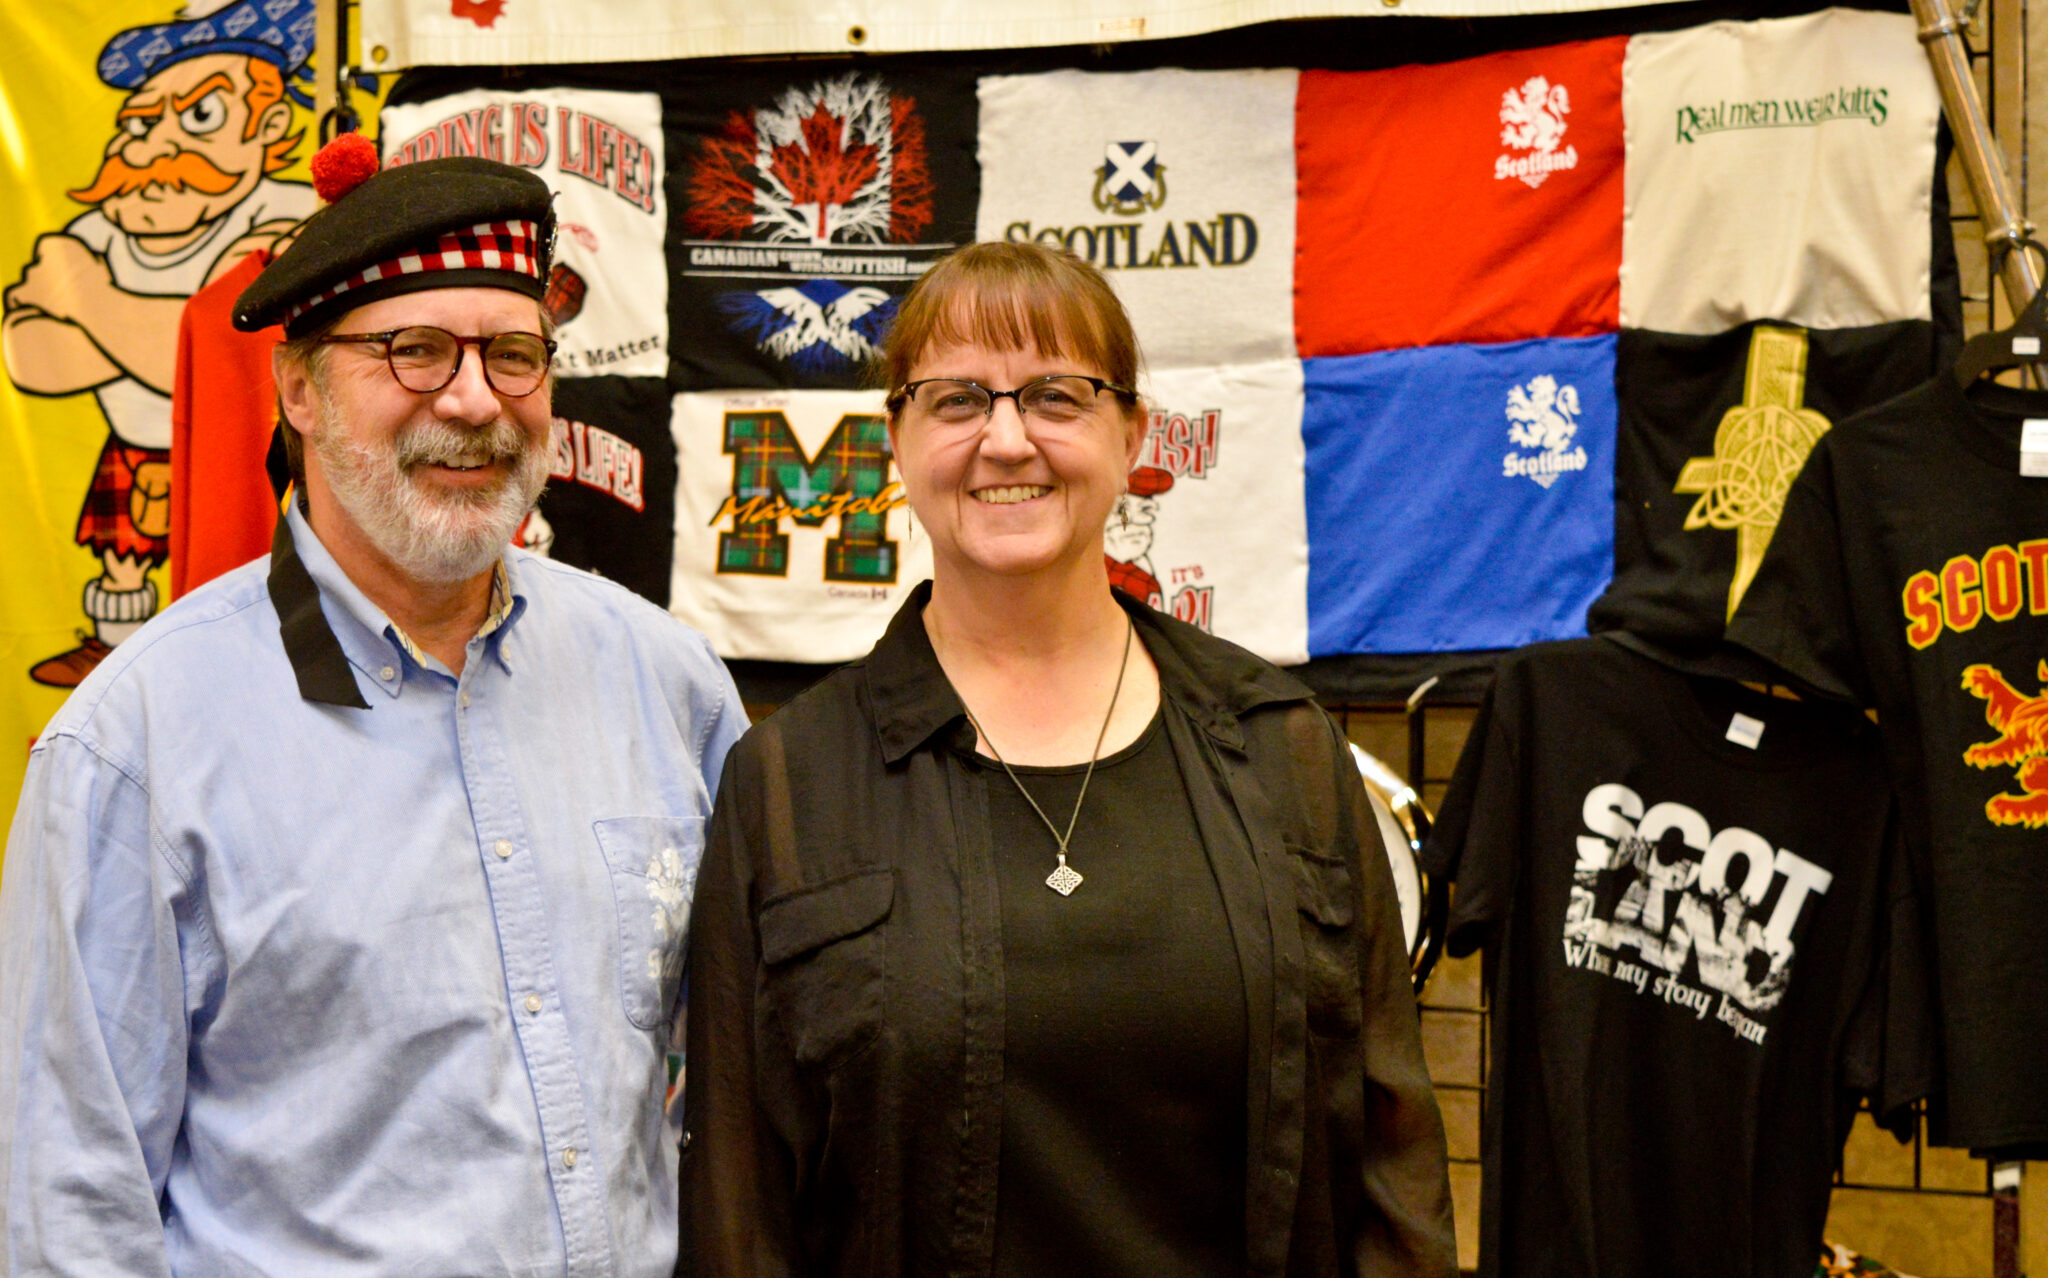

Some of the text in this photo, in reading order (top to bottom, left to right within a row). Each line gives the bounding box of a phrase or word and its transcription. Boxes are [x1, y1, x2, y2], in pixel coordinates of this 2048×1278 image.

[1676, 102, 1725, 144] Real
[1730, 99, 1780, 125] men
[511, 102, 549, 170] IS
[557, 106, 656, 215] LIFE!
[1494, 144, 1578, 180] Scotland
[690, 248, 779, 267] CANADIAN
[821, 256, 907, 276] SCOTTISH
[586, 334, 660, 367] Matter
[572, 421, 645, 513] LIFE!
[1502, 446, 1588, 478] Scotland
[708, 480, 908, 527] Manitob
[1902, 538, 2048, 650] SCOT
[1576, 783, 1834, 948] SCOT
[1613, 960, 1650, 995] my
[1653, 972, 1713, 1020] story
